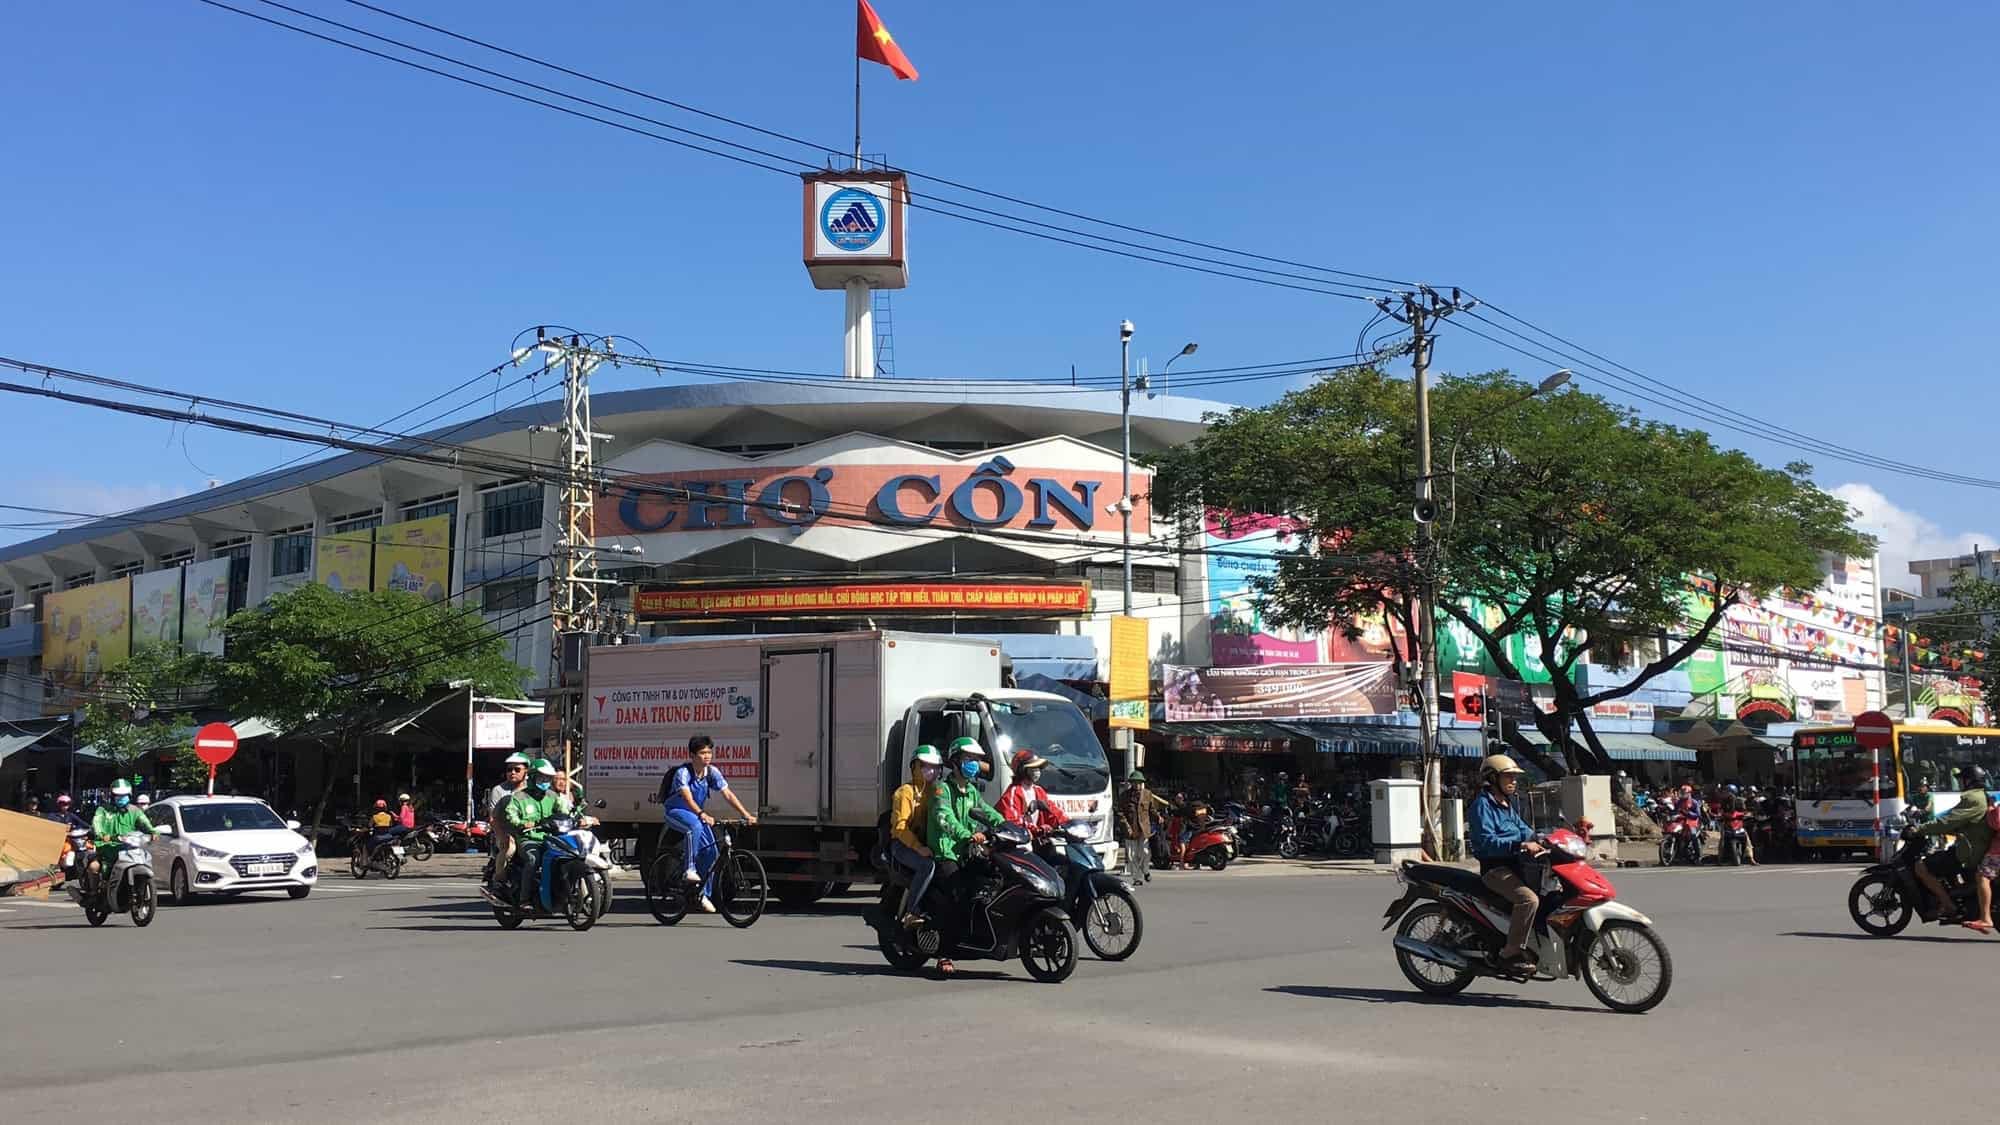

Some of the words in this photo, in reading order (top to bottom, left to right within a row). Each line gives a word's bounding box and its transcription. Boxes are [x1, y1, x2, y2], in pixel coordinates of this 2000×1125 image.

[618, 467, 834, 535] CHỢ
[878, 455, 1101, 530] CỒN
[633, 690, 641, 701] TY
[616, 707, 648, 724] DANA
[651, 704, 690, 723] TRUNG
[733, 744, 753, 760] NAM
